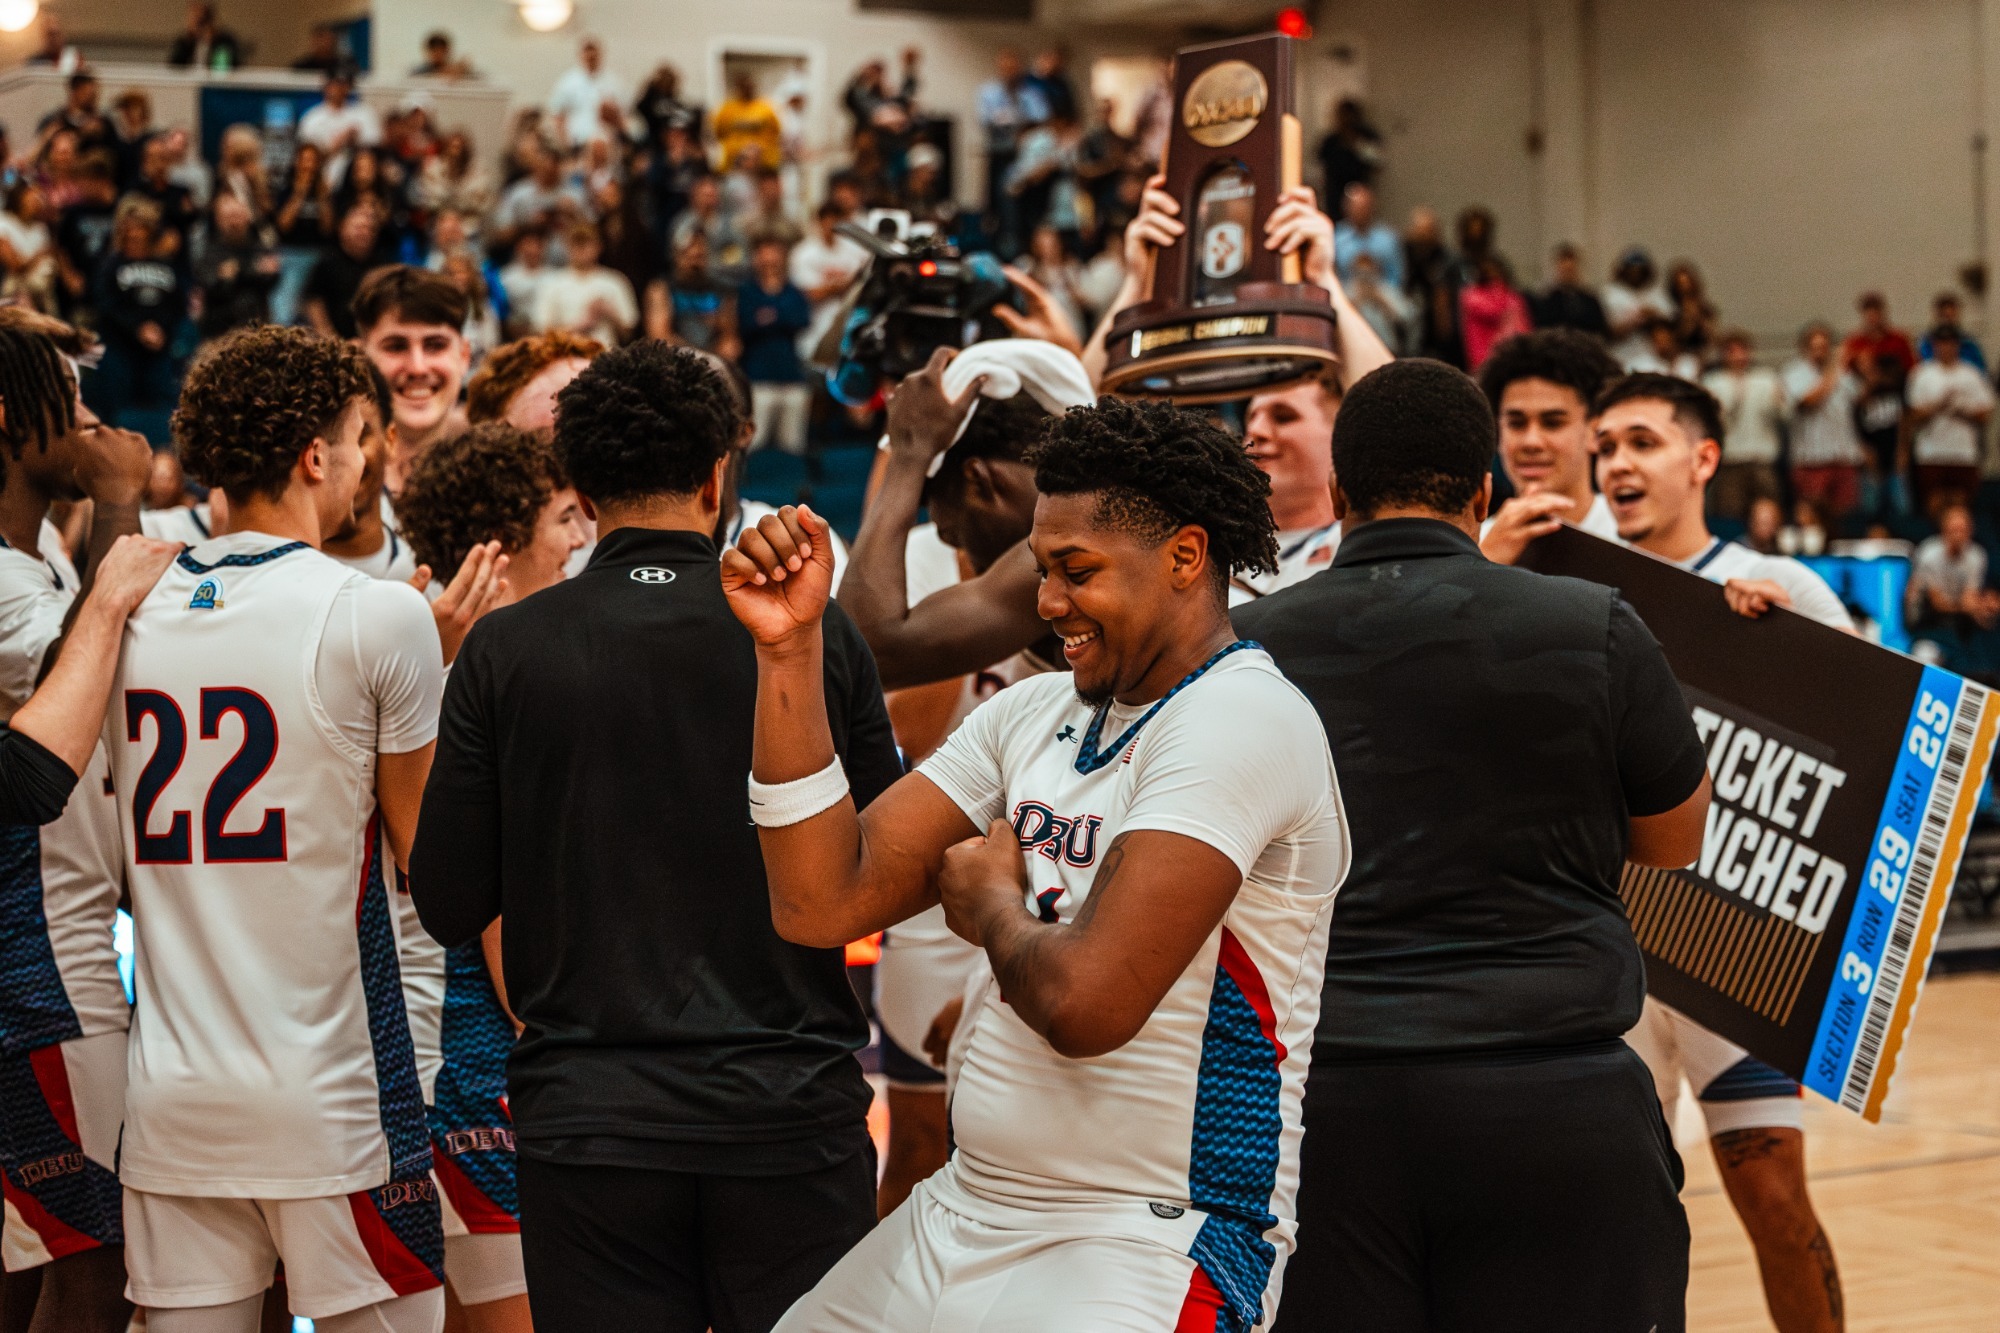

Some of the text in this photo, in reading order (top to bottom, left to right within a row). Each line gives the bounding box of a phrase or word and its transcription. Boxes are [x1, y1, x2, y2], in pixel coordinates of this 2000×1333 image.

[125, 686, 288, 864] 22
[1013, 800, 1103, 868] DBU
[1685, 801, 1848, 935] NCHED
[1817, 690, 1950, 1084] SECTION 3 ROW 29 SEAT 25
[19, 1152, 84, 1188] DBU
[446, 1127, 516, 1155] DBU
